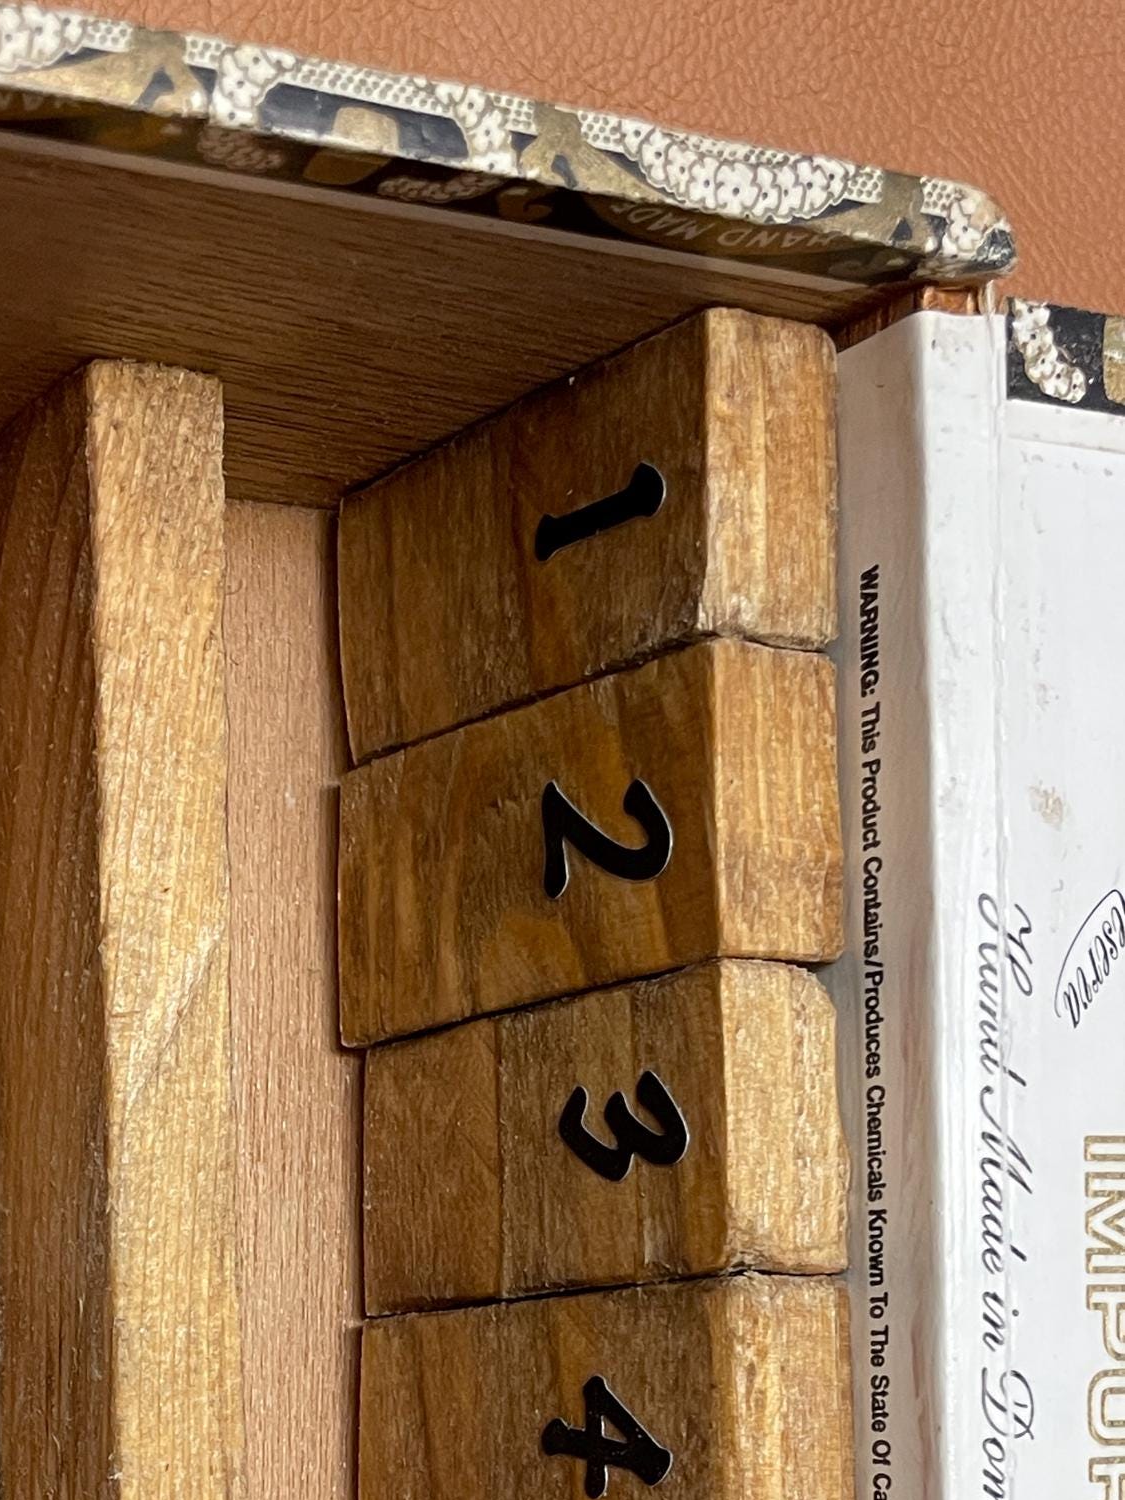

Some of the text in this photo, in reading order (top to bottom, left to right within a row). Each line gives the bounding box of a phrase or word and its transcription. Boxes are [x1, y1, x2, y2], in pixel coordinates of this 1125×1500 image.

[535, 462, 666, 561] 1
[859, 564, 880, 697] WARNING:
[861, 702, 881, 753] This
[544, 779, 672, 899] 2
[862, 760, 881, 851] Product
[978, 893, 1033, 1087] Hand
[1064, 906, 1125, 1028] eserva
[559, 1070, 689, 1182] 3
[867, 1085, 887, 1202] Chemicals
[980, 1086, 1033, 1274] Made
[868, 1209, 888, 1286] Known
[869, 1292, 889, 1319] To
[870, 1325, 889, 1367] The
[982, 1291, 1019, 1352] in
[541, 1375, 673, 1499] 4
[871, 1375, 890, 1432] State
[872, 1440, 892, 1465] Of
